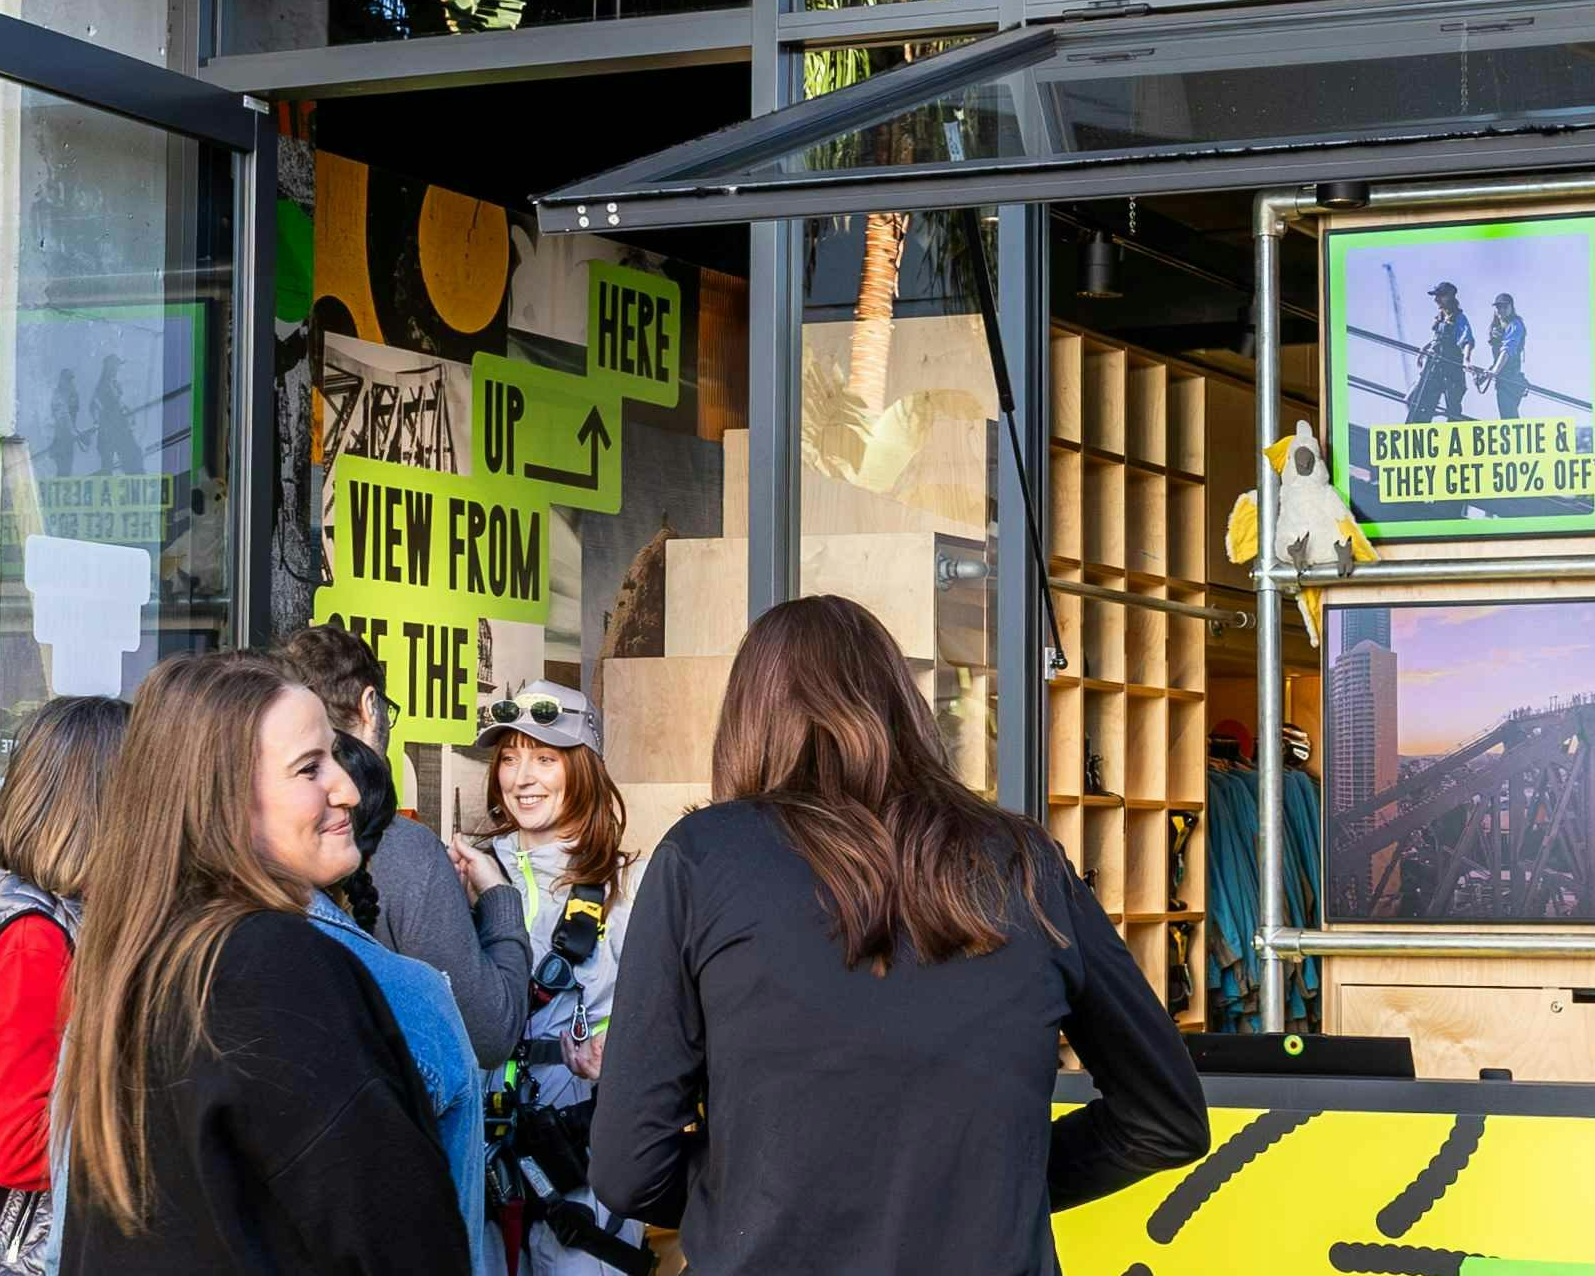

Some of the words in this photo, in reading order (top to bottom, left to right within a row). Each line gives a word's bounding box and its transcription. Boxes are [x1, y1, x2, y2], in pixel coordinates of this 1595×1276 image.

[597, 281, 671, 383] HERE
[484, 380, 525, 475] UP
[1375, 427, 1439, 461] BRING
[1448, 427, 1463, 457] A
[1473, 422, 1546, 456] BESTIE
[1555, 422, 1570, 453] &
[1383, 464, 1437, 497] THEY
[1445, 463, 1484, 494] GET
[1493, 461, 1545, 493] 50%
[349, 480, 433, 587] VIEW
[449, 498, 541, 602] FROM
[403, 620, 468, 721] THE
